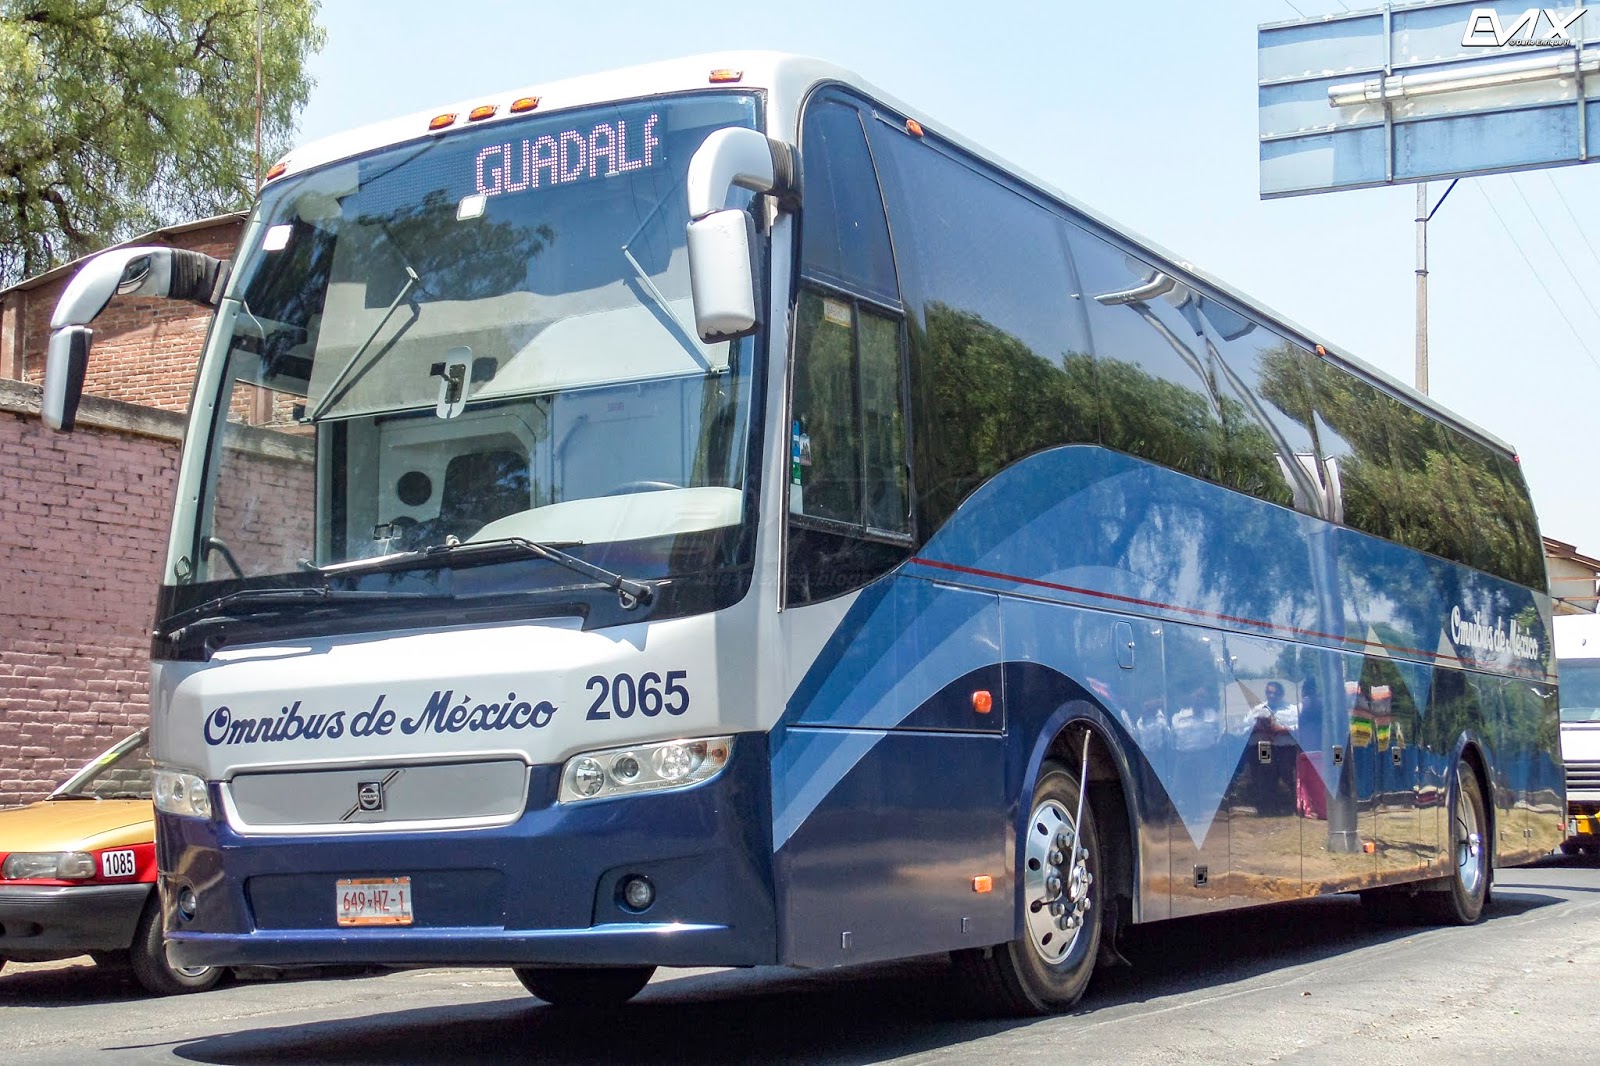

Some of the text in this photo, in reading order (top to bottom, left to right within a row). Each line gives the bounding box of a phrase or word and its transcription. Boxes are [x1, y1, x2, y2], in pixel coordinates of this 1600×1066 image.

[1451, 605, 1493, 652] Omnibus
[1494, 616, 1505, 653] de
[204, 691, 558, 746] Omnibus de México
[586, 670, 690, 720] 2065
[106, 852, 133, 875] 1085
